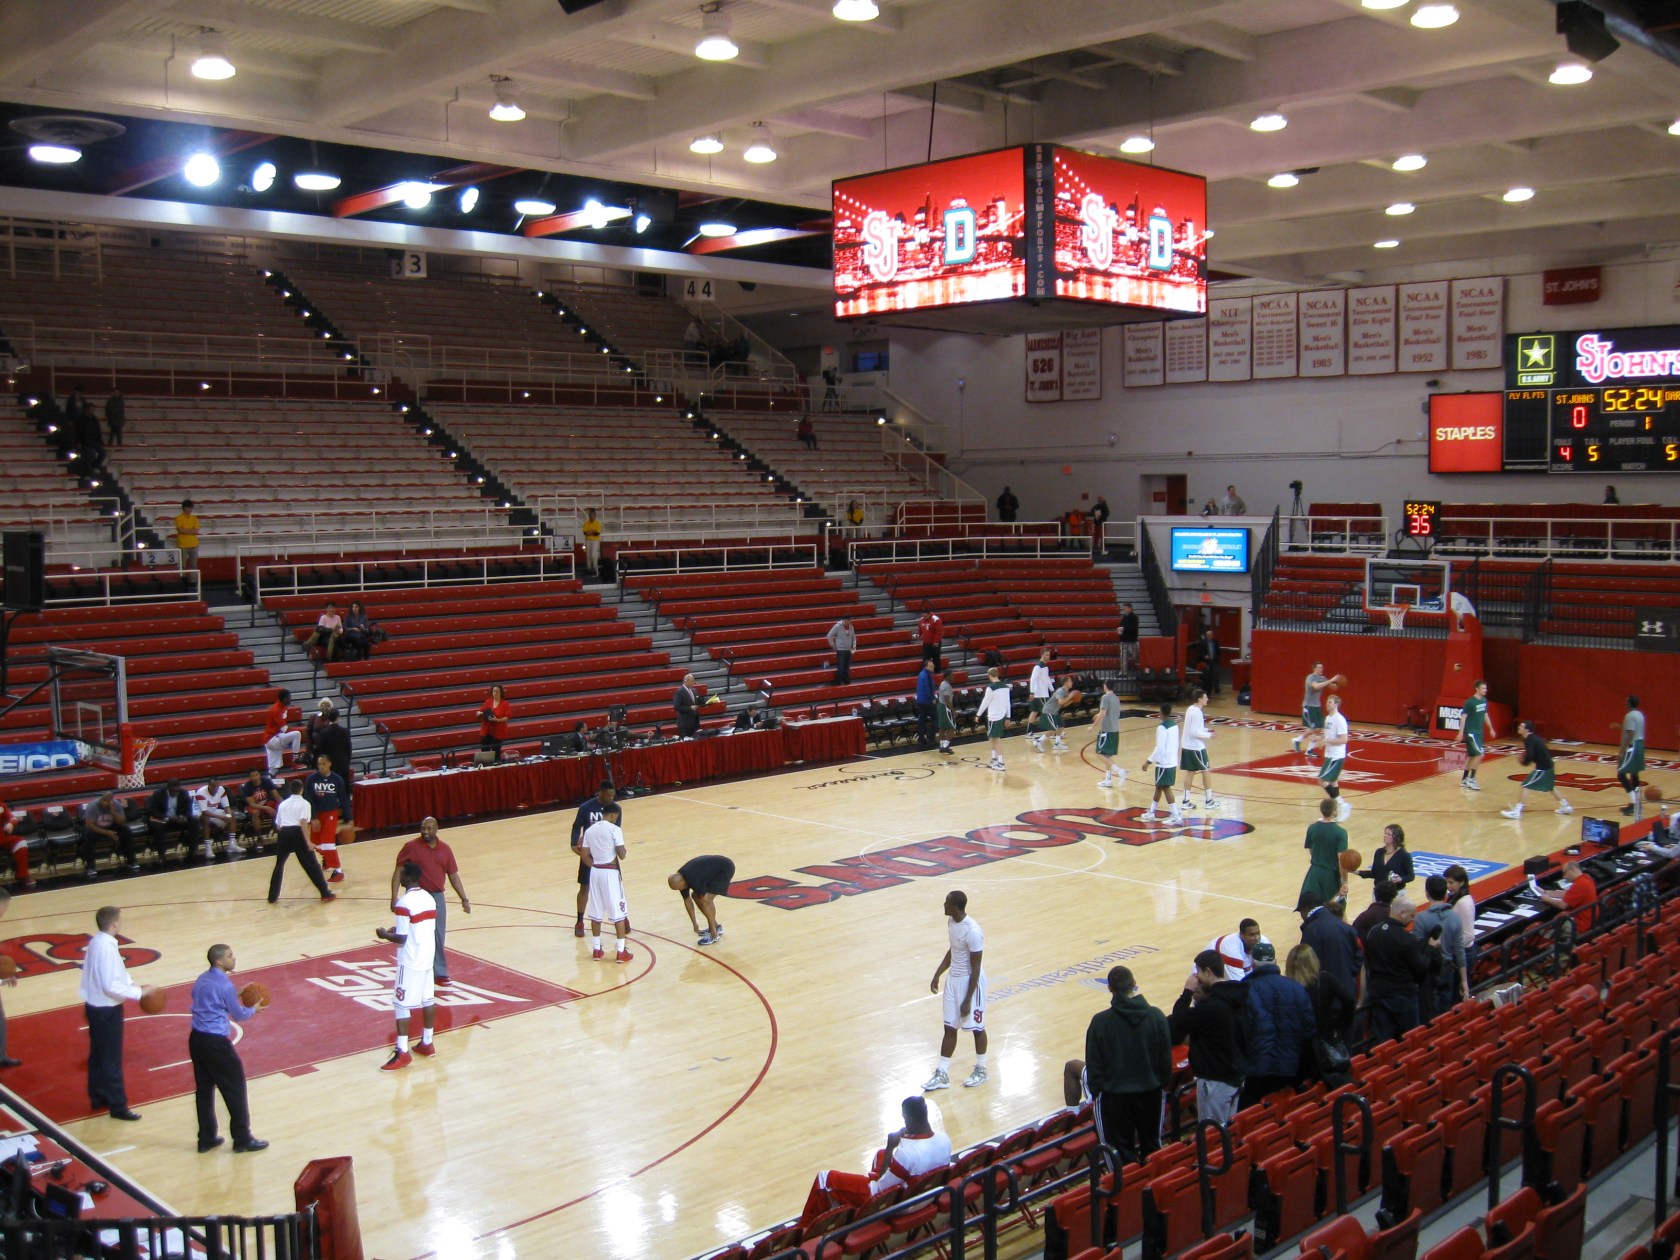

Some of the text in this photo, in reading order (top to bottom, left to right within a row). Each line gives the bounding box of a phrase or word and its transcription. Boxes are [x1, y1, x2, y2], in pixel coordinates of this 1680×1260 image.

[943, 206, 977, 267] D
[1149, 215, 1173, 272] D
[410, 254, 422, 274] 3
[1561, 278, 1598, 291] JOHN'S
[1407, 292, 1440, 303] NCAA
[1460, 287, 1495, 299] NCAA
[1260, 300, 1290, 311] NCAA
[1306, 300, 1337, 311] NCAA
[1356, 296, 1387, 307] NCAA
[1220, 308, 1239, 319] NIT
[1604, 388, 1665, 411] 52:24
[1573, 406, 1587, 428] 0
[1609, 419, 1636, 428] PERIOD
[1435, 426, 1496, 441] STAPLES
[1560, 446, 1571, 461] 4
[1587, 445, 1599, 462] 5
[1665, 444, 1678, 461] 5
[1406, 503, 1435, 515] 52:24
[1410, 514, 1431, 534] 35
[1445, 718, 1461, 730] MIL
[314, 782, 336, 791] NYC
[589, 811, 604, 822] NY
